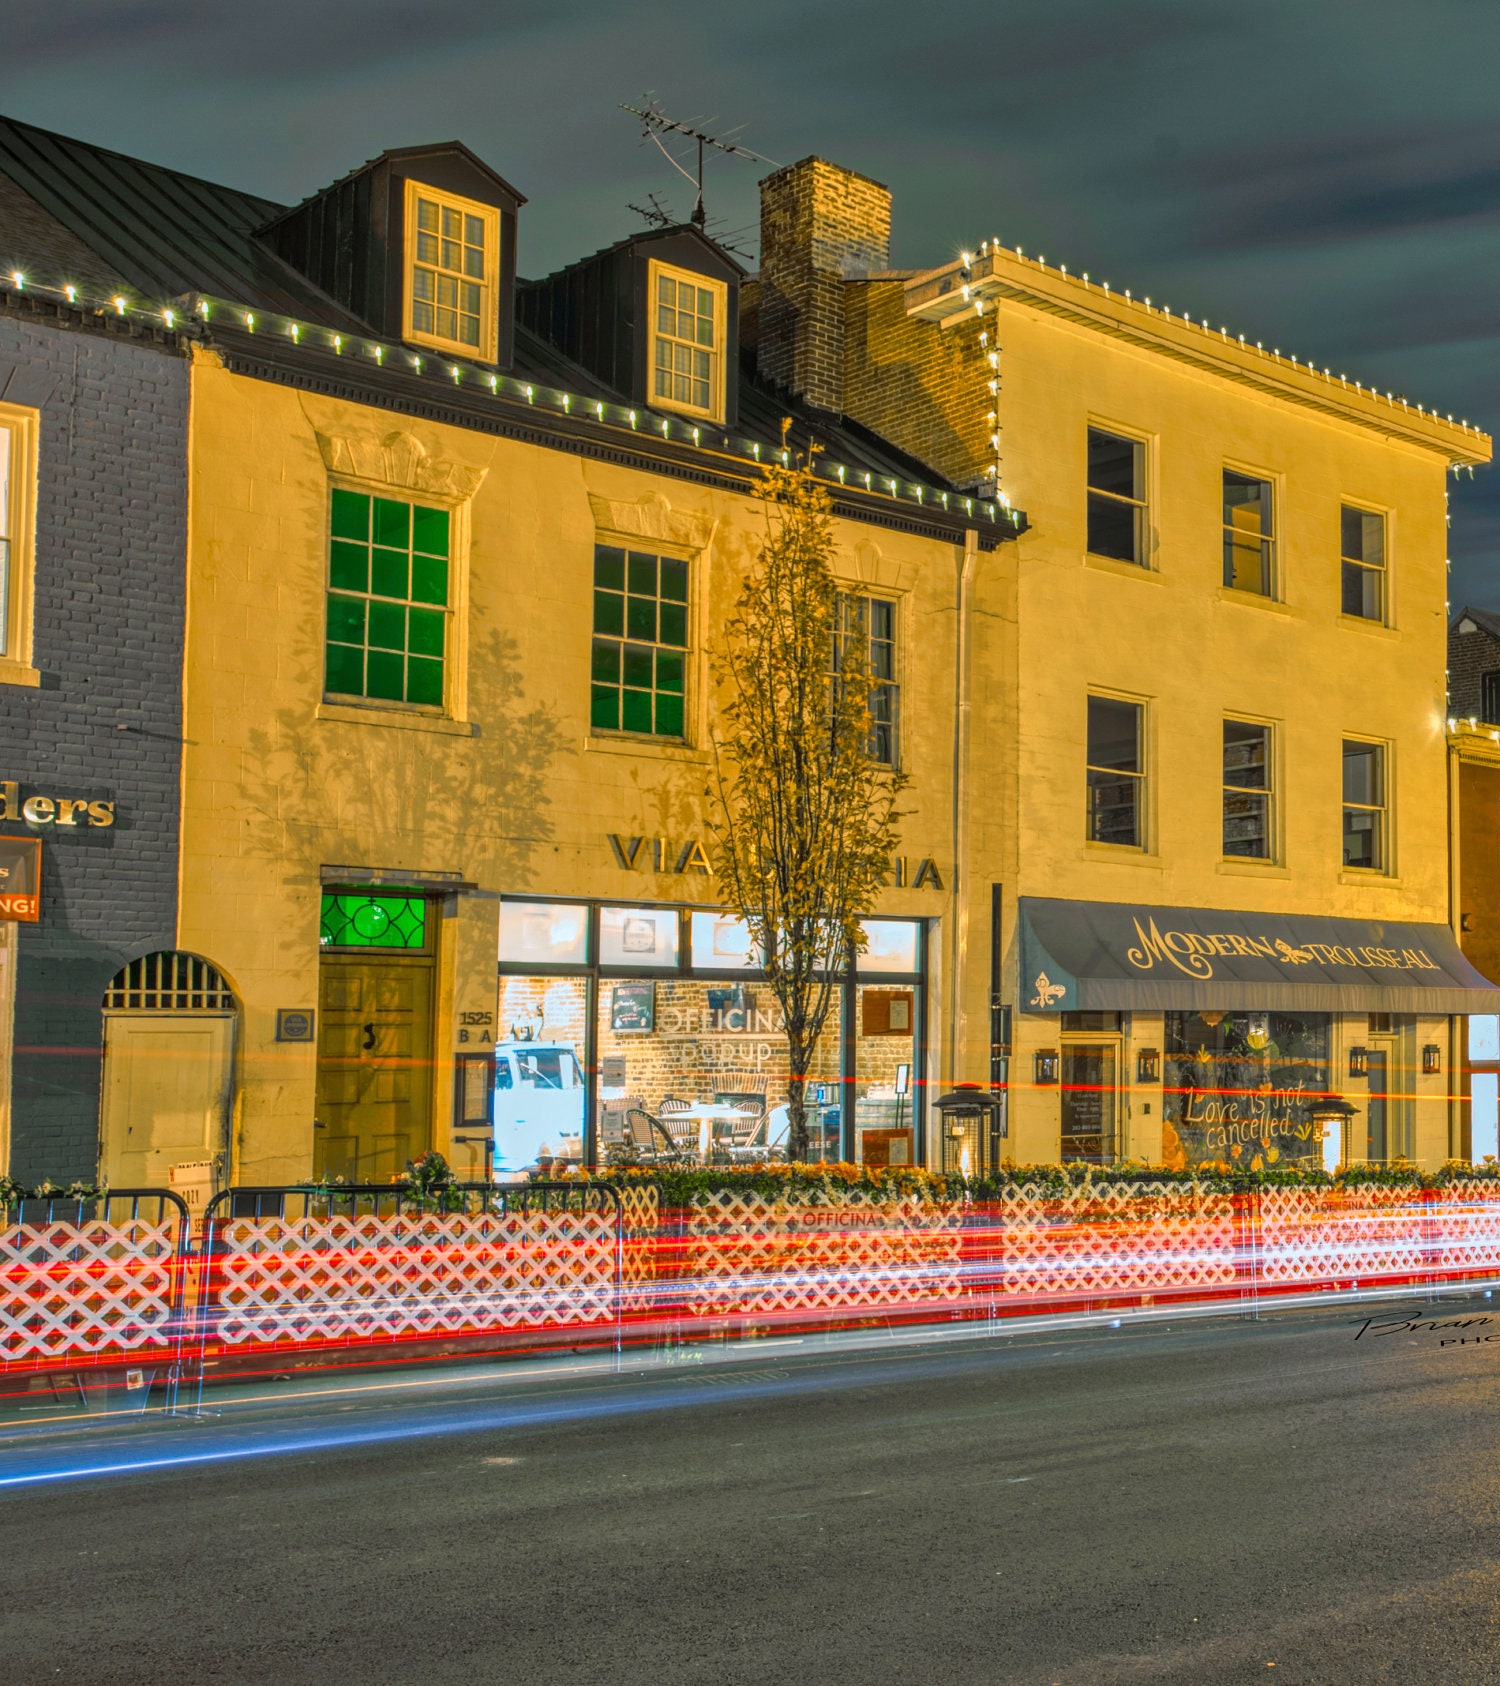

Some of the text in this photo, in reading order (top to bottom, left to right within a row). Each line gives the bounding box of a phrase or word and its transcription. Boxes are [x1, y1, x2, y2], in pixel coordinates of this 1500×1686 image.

[606, 833, 714, 875] VIA
[1127, 915, 1437, 980] MODERN TROUSSEAU
[458, 1029, 492, 1043] B A
[459, 1011, 492, 1026] 1525
[1185, 1086, 1239, 1123] Love
[1273, 1079, 1305, 1110] not
[1206, 1108, 1296, 1149] cancelled
[802, 1211, 877, 1227] OFFICINA
